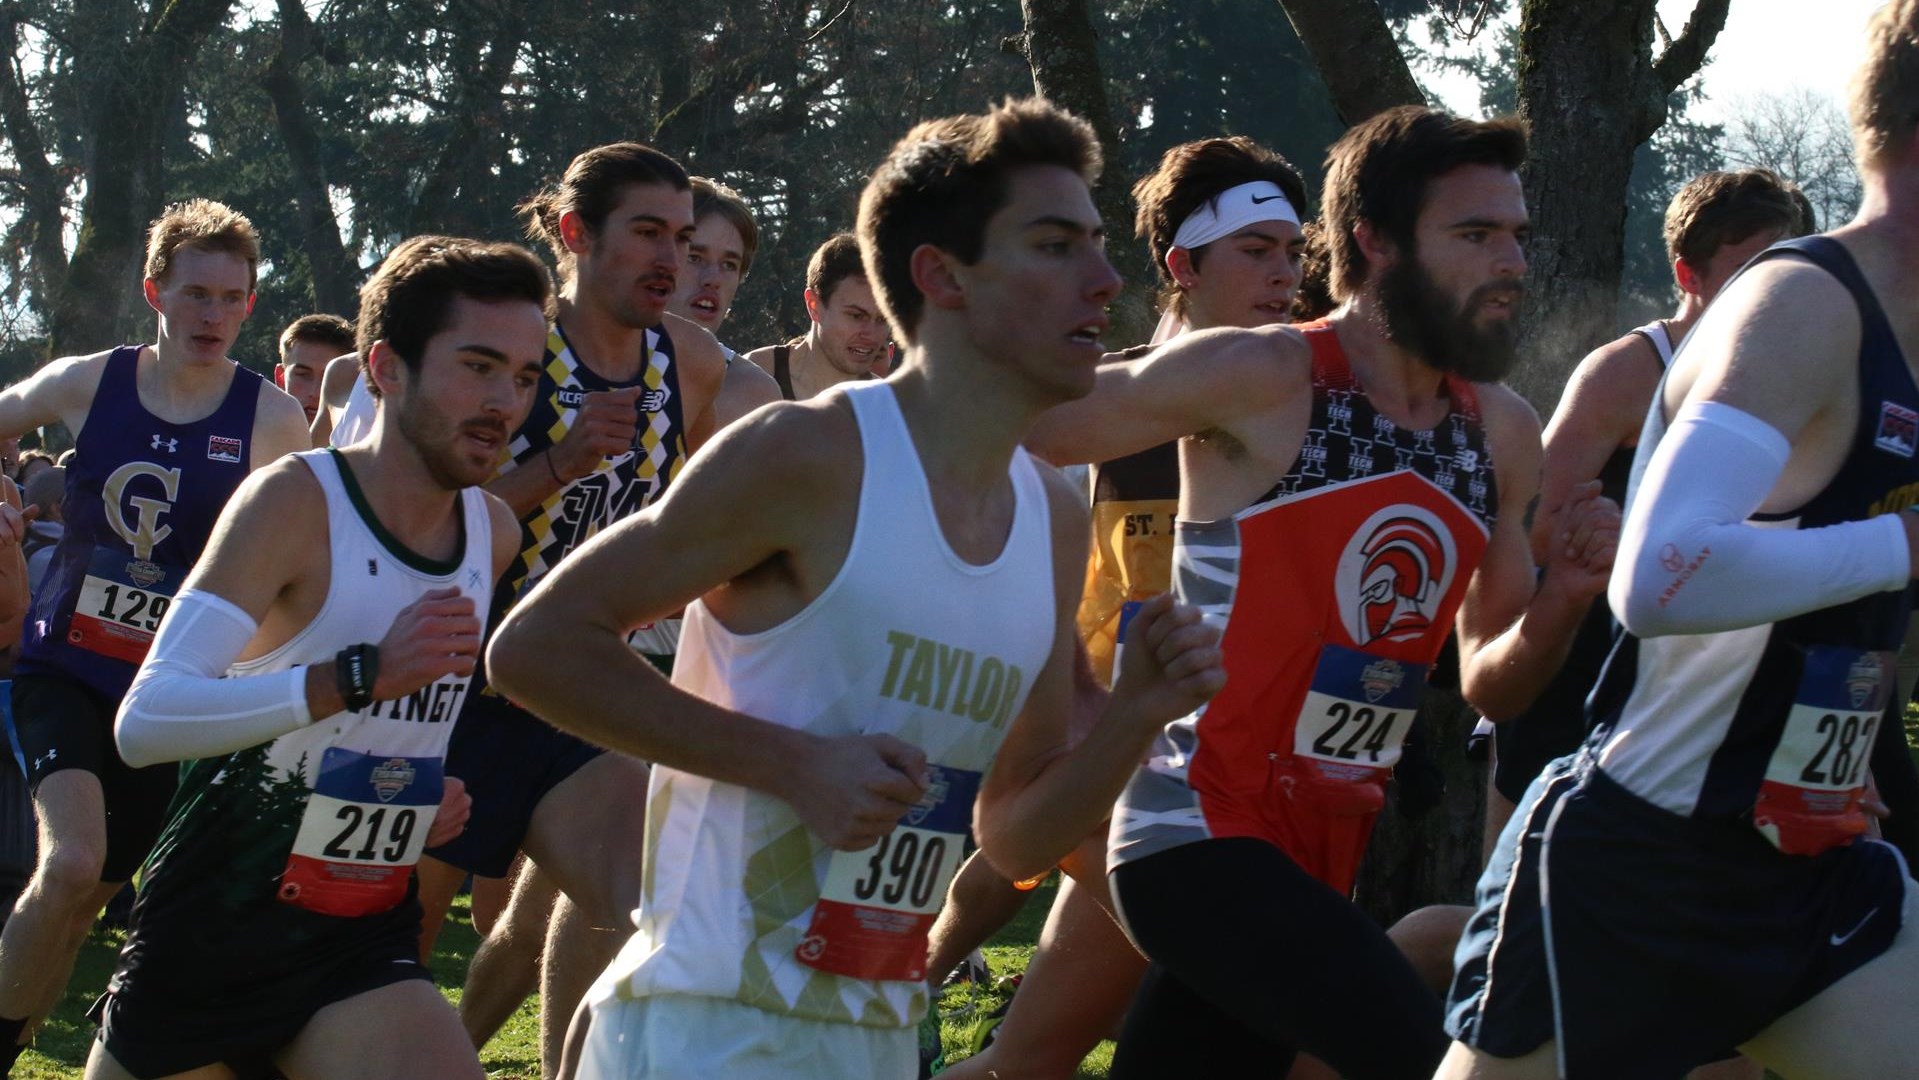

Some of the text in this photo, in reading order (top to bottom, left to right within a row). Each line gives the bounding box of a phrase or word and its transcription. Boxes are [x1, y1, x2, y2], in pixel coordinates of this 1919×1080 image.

[1125, 514, 1157, 536] ST.
[98, 585, 171, 630] 129
[880, 630, 1022, 729] TAYLOR
[1312, 702, 1397, 763] 224
[322, 805, 416, 863] 219
[855, 831, 946, 908] 390
